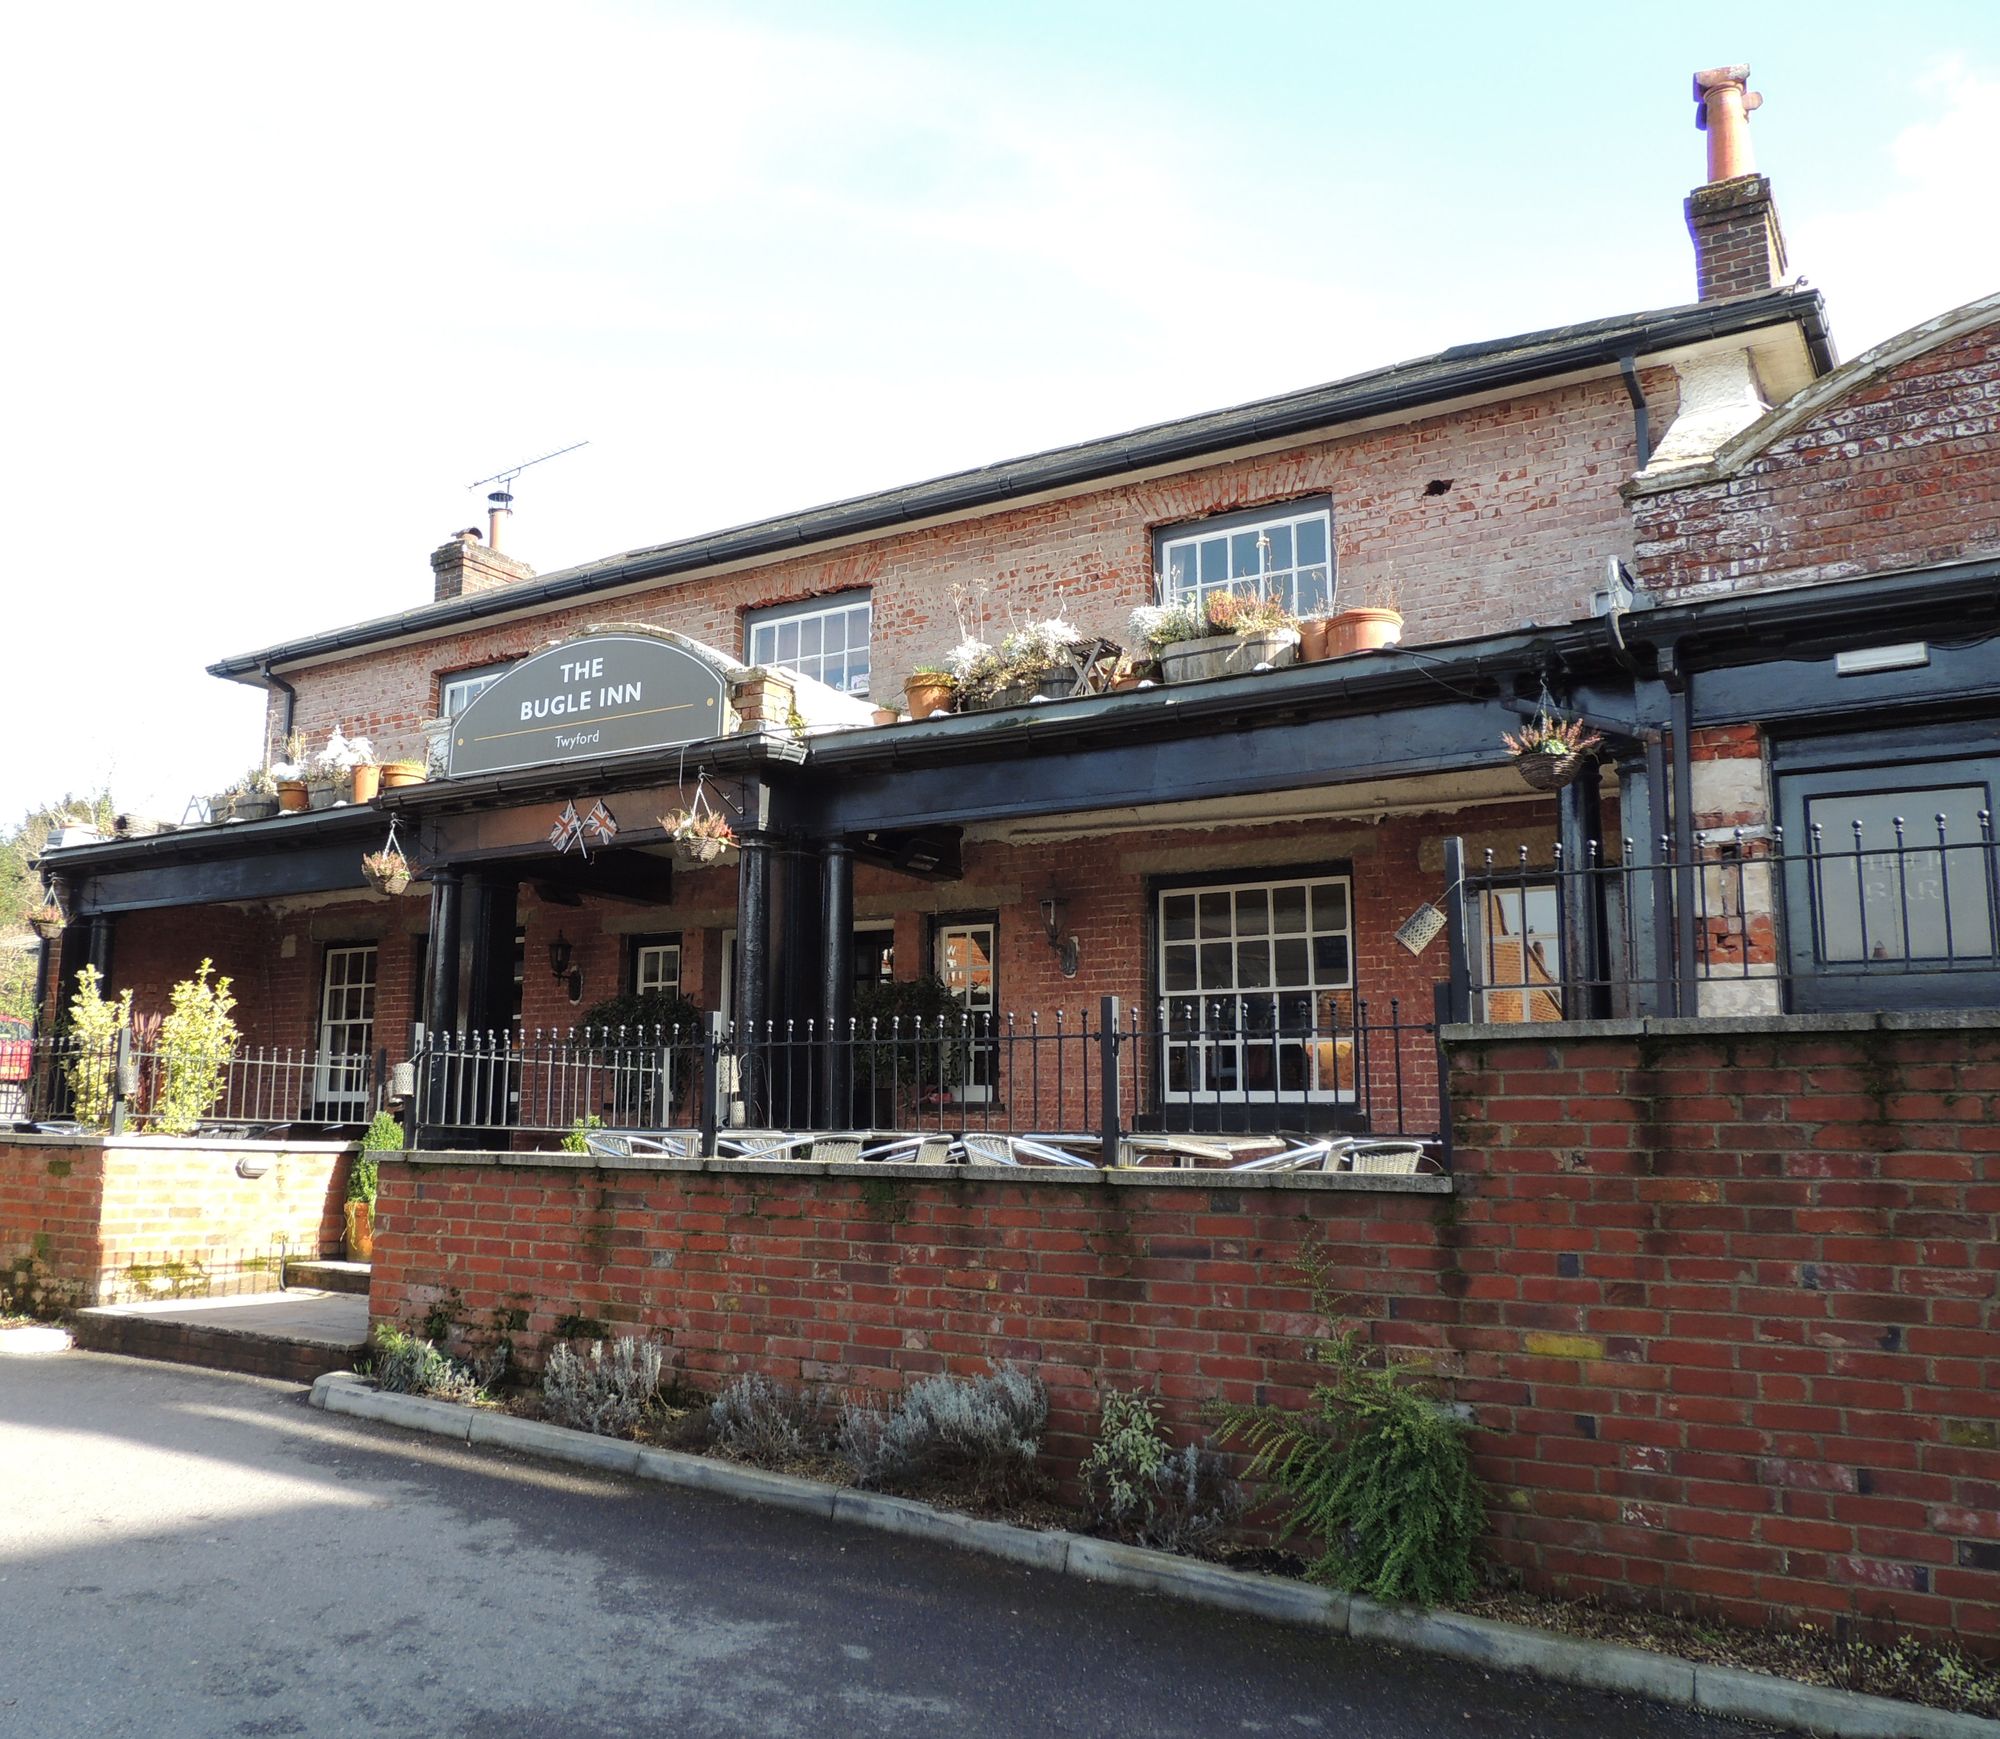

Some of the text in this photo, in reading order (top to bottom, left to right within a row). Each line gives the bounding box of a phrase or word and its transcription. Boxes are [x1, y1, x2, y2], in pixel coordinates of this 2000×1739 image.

[560, 657, 603, 683] THE
[520, 681, 641, 720] BUGLE INN
[555, 729, 600, 750] Twyford
